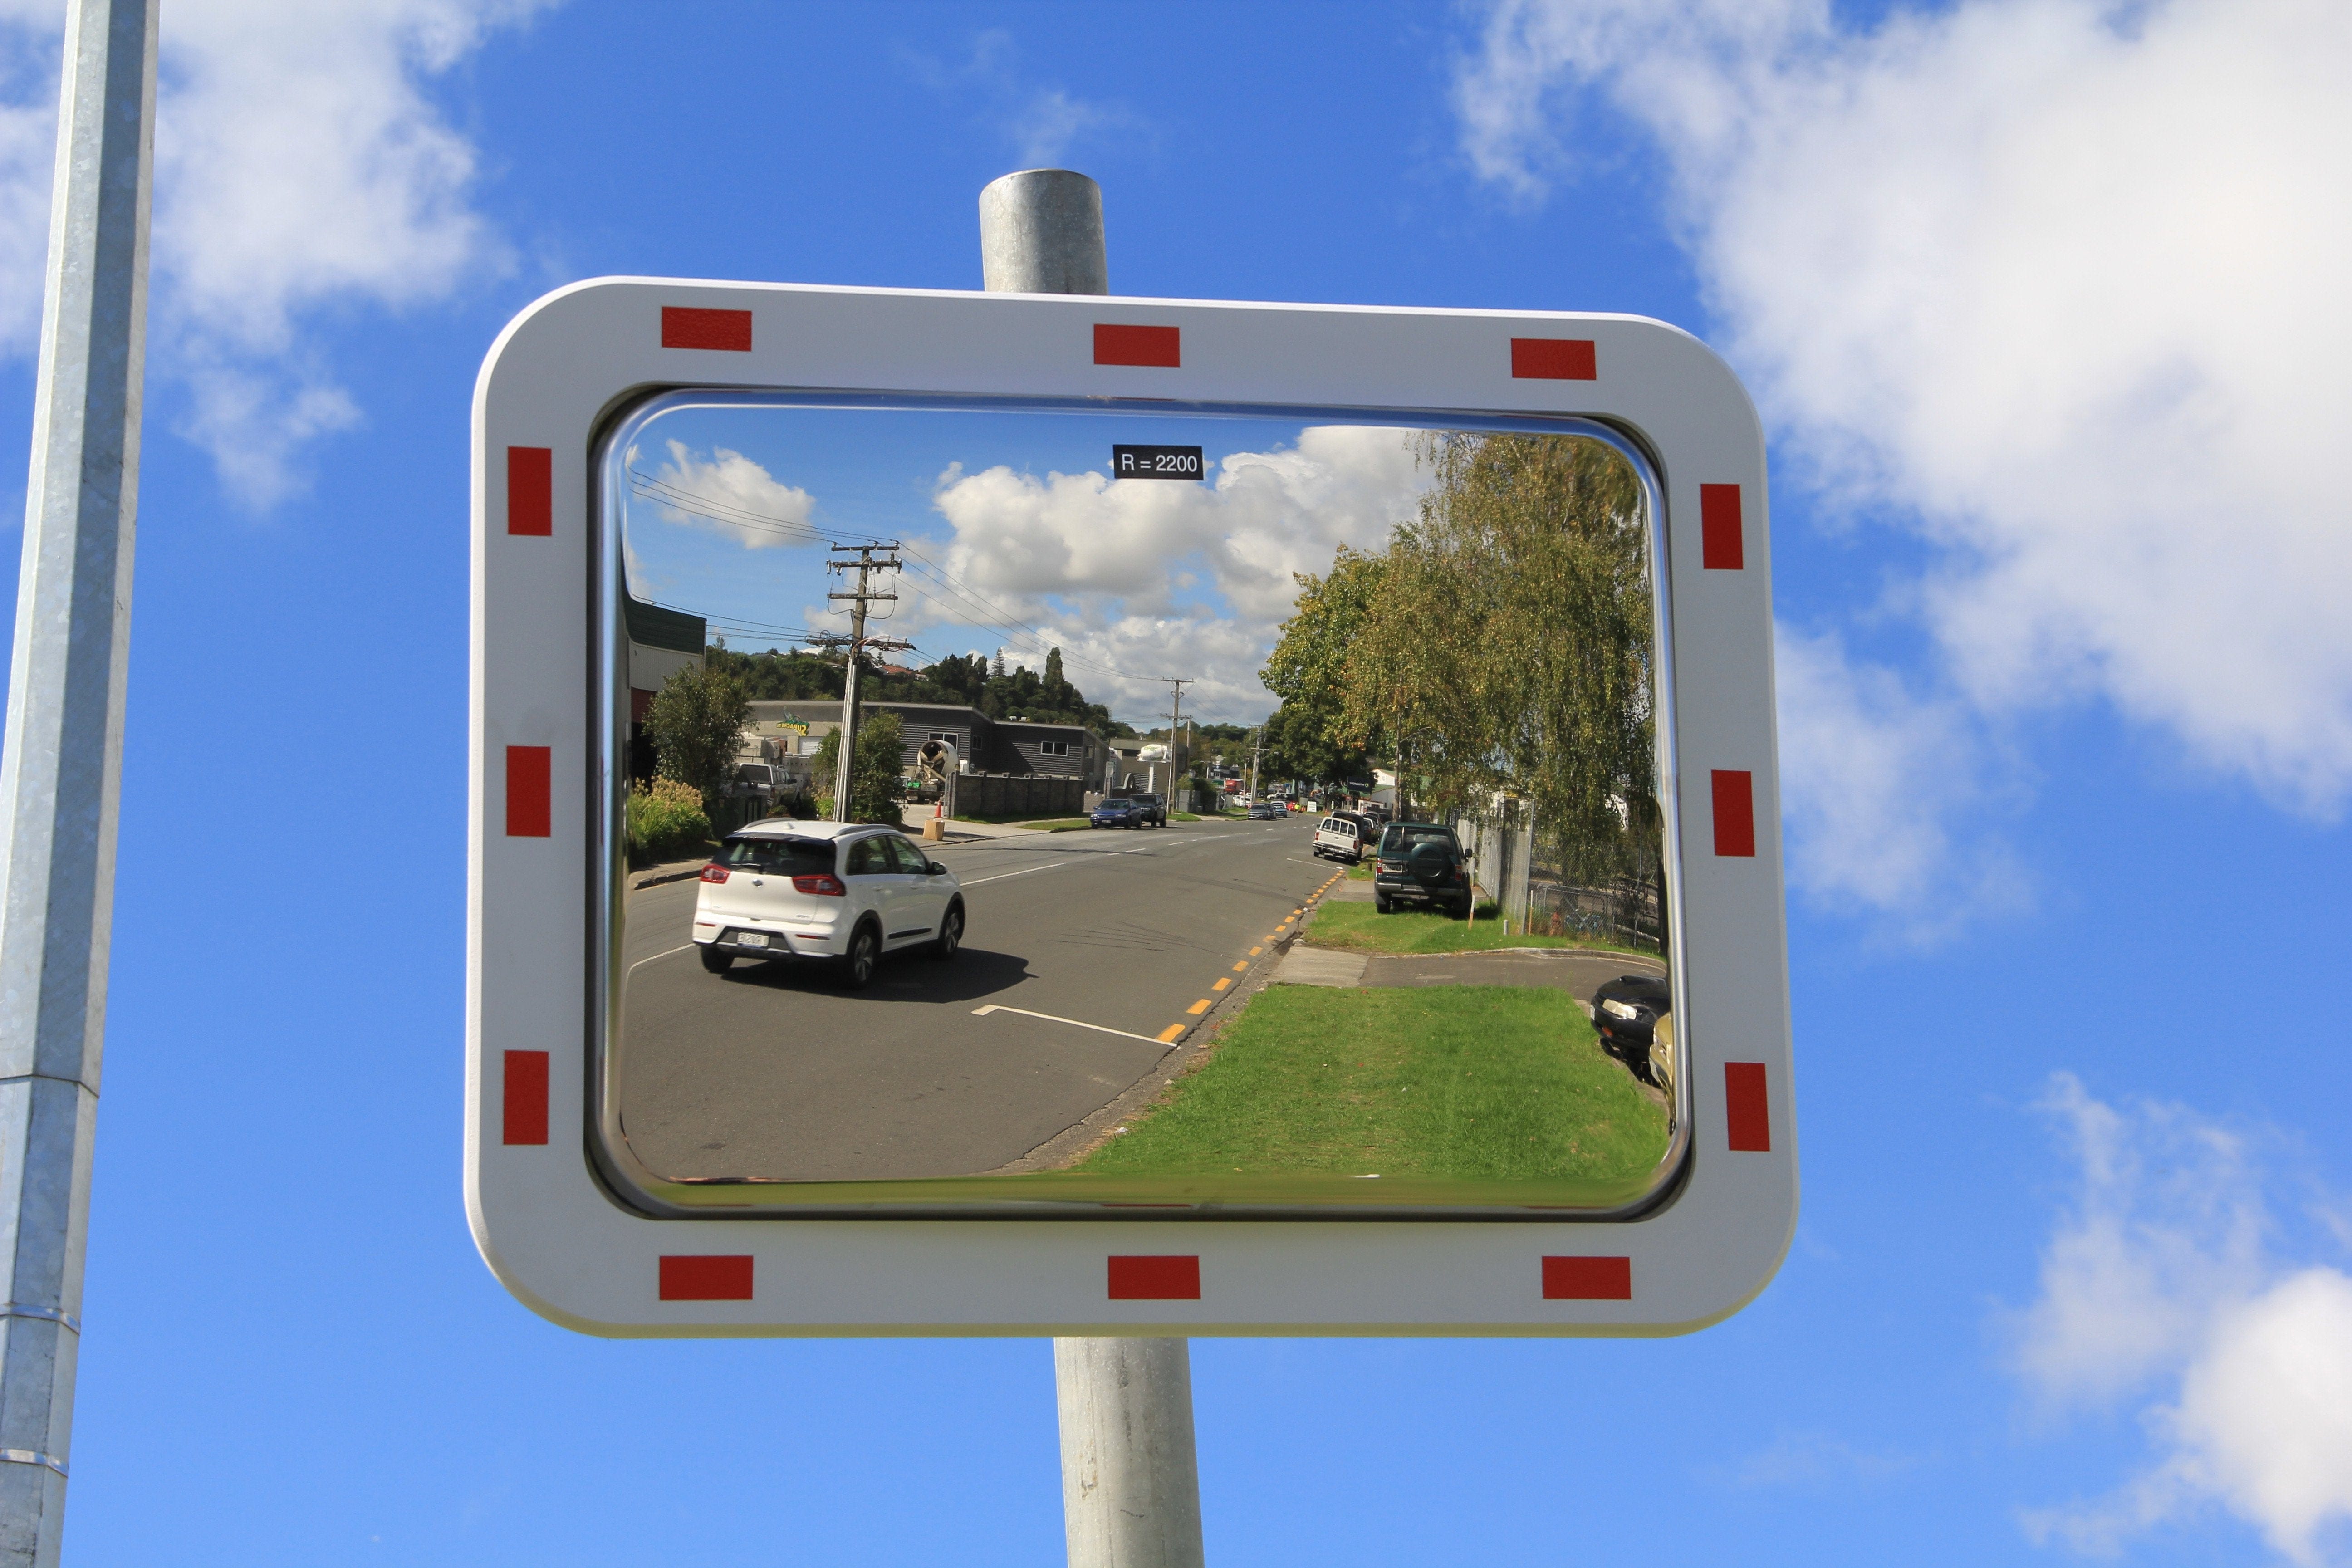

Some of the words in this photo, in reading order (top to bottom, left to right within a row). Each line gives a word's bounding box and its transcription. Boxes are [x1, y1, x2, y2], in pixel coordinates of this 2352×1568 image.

[1122, 453, 1135, 470] R
[1140, 461, 1151, 469] =
[1156, 455, 1198, 472] 2200
